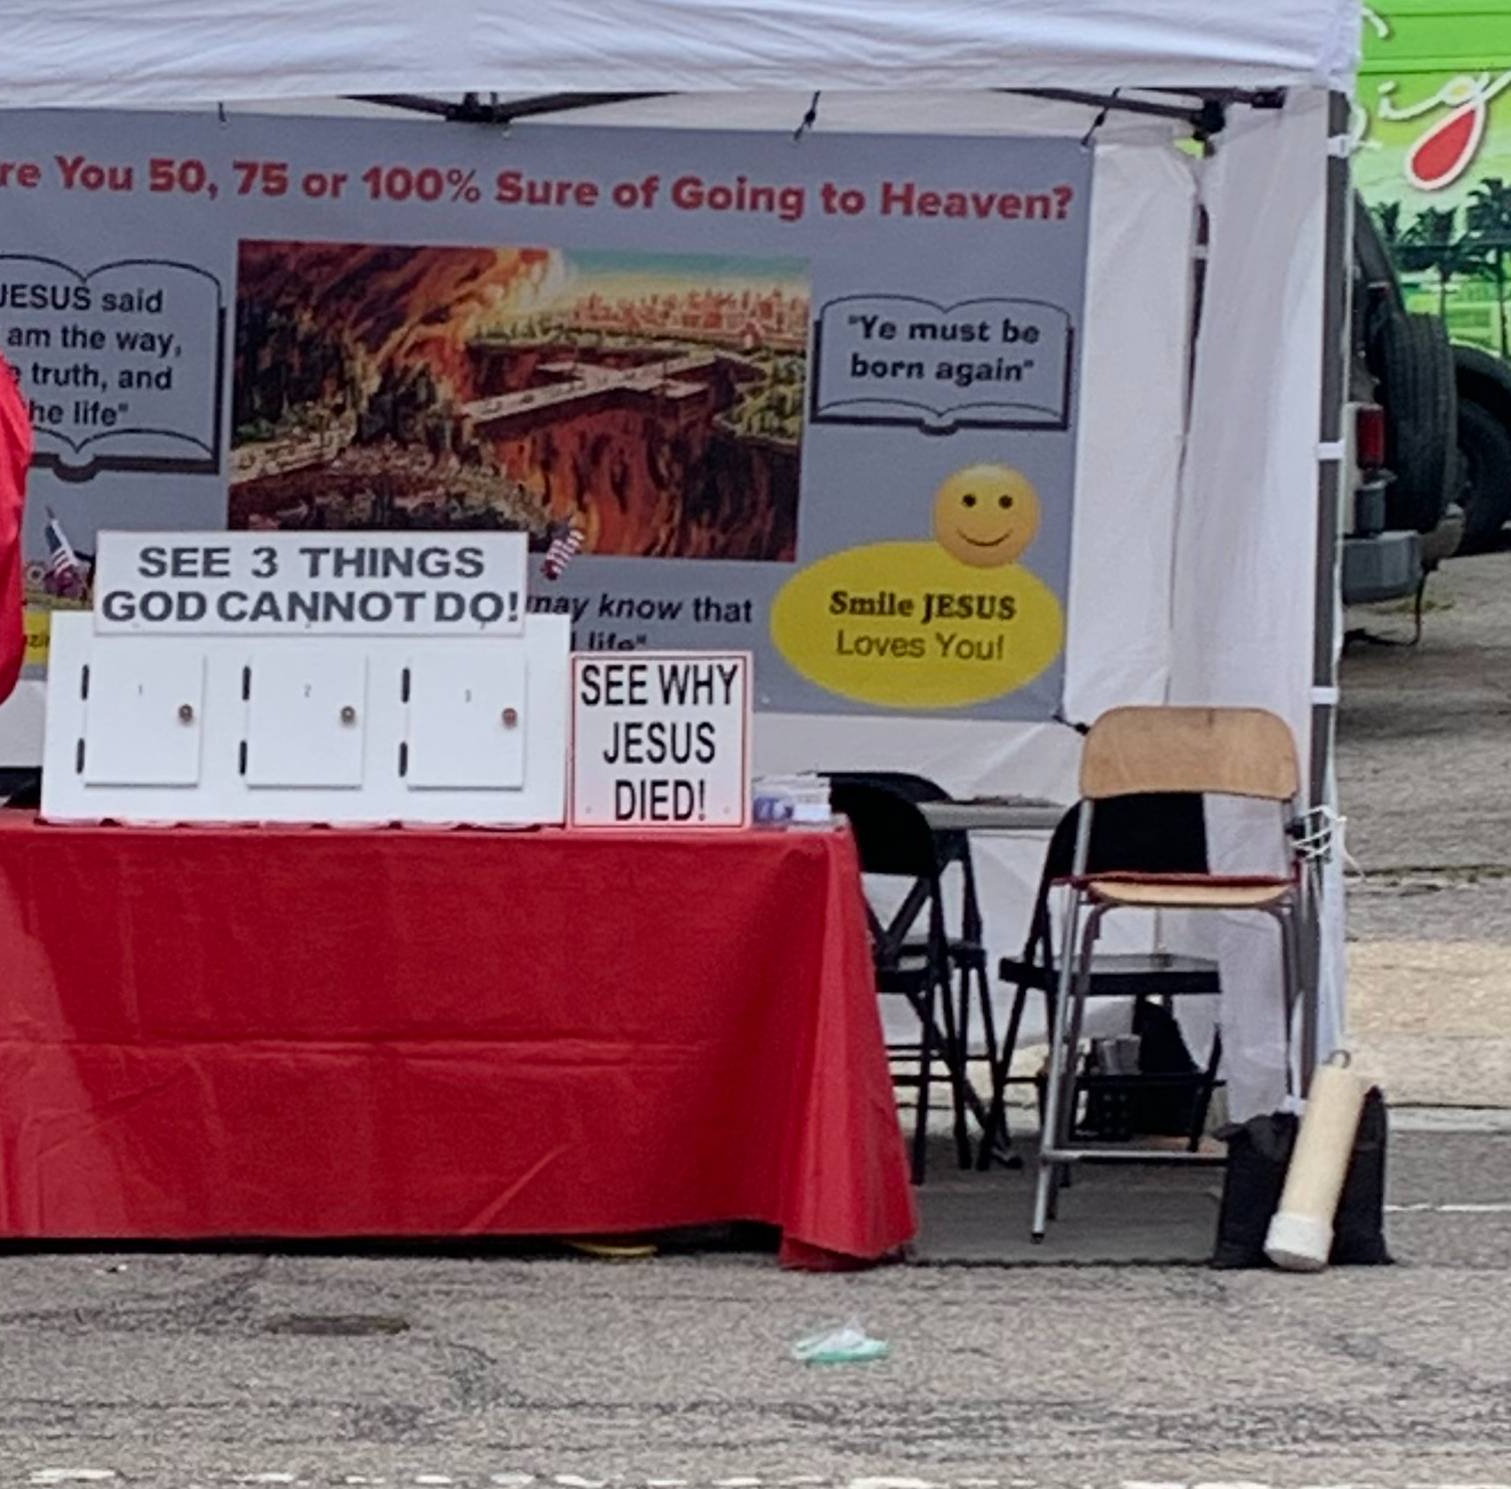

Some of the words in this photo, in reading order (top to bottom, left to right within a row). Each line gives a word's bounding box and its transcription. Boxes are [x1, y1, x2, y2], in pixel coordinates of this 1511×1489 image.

[54, 155, 133, 191] You
[149, 158, 218, 200] 50,
[233, 160, 288, 197] 75
[301, 170, 347, 198] or
[362, 165, 481, 203] 100%
[496, 170, 599, 207] Sure
[611, 175, 659, 209] of
[671, 175, 805, 222] Going
[821, 181, 865, 214] to
[880, 182, 1074, 220] Heaven?
[102, 289, 163, 313] said
[8, 327, 50, 347] am
[61, 323, 105, 350] the
[116, 331, 182, 357] way,
[848, 314, 896, 340] "Ye
[909, 322, 990, 342] must
[1002, 318, 1040, 344] be
[32, 362, 107, 391] truth,
[118, 367, 172, 390] and
[851, 352, 924, 379] born
[936, 358, 1034, 387] again"
[29, 400, 63, 424] he
[74, 401, 128, 426] life"
[138, 547, 231, 579] SEE
[251, 547, 278, 579] 3
[299, 547, 484, 578] THINGS
[102, 590, 207, 622] GOD
[217, 590, 426, 622] CANNOT
[435, 591, 519, 622] DO!
[527, 594, 589, 623] may
[598, 593, 683, 620] know
[693, 597, 752, 622] that
[829, 590, 914, 617] Smile
[921, 593, 1017, 624] JESUS
[589, 630, 647, 651] life"
[836, 629, 926, 658] Loves
[935, 632, 1004, 660] You!
[581, 664, 648, 706] SEE
[658, 664, 738, 706] WHY
[603, 721, 716, 764] JESUS
[615, 779, 705, 822] DIED!
